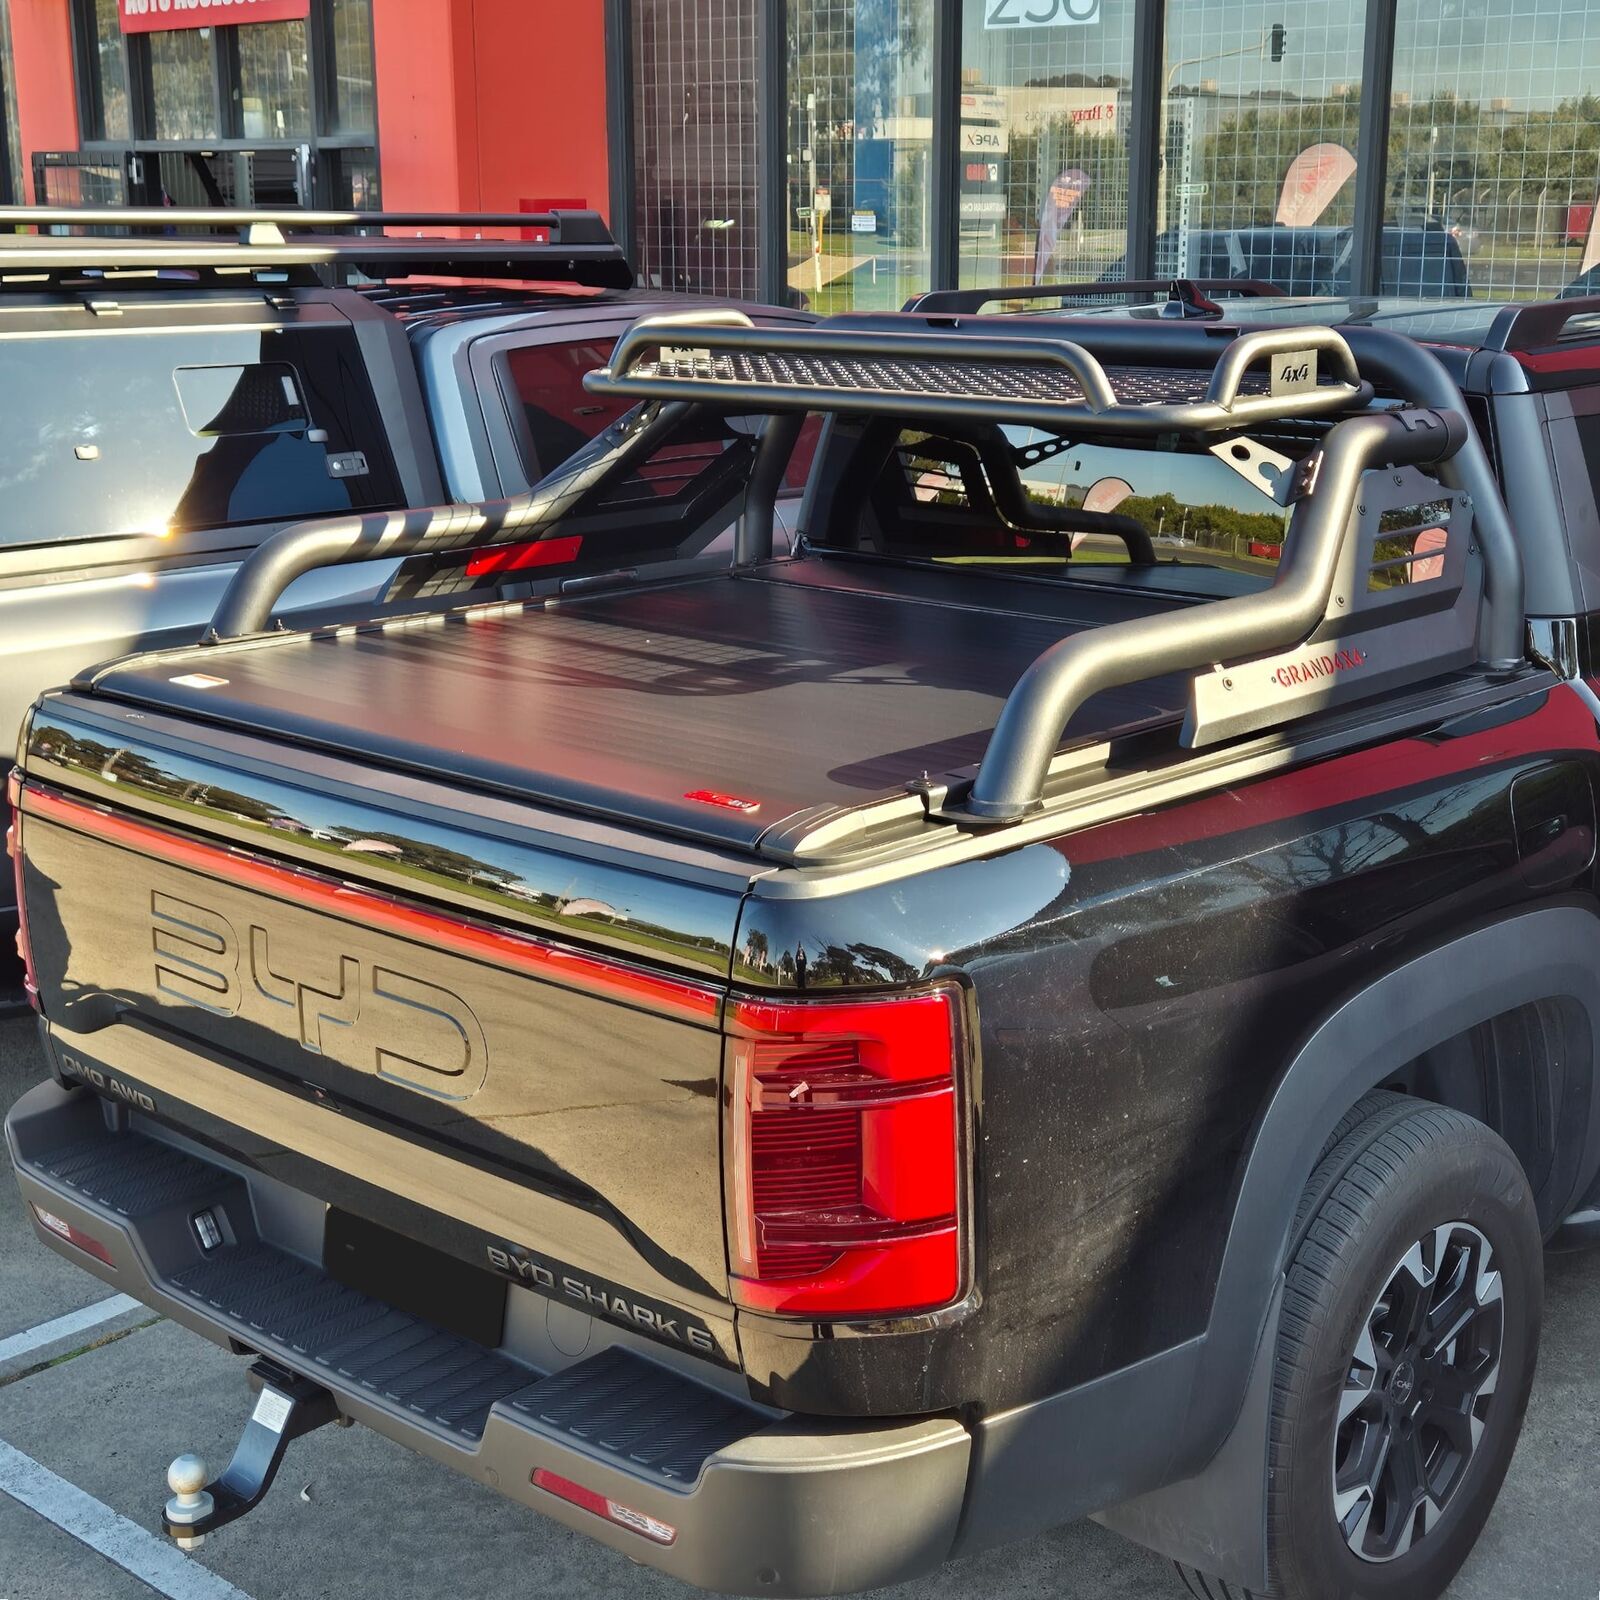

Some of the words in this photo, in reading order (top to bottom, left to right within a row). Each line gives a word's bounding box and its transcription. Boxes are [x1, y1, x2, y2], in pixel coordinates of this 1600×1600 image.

[151, 888, 489, 1101] BYD
[111, 1078, 155, 1112] AWD
[487, 1245, 554, 1289] BYD
[562, 1276, 681, 1340] SHARK
[687, 1326, 715, 1352] 6
